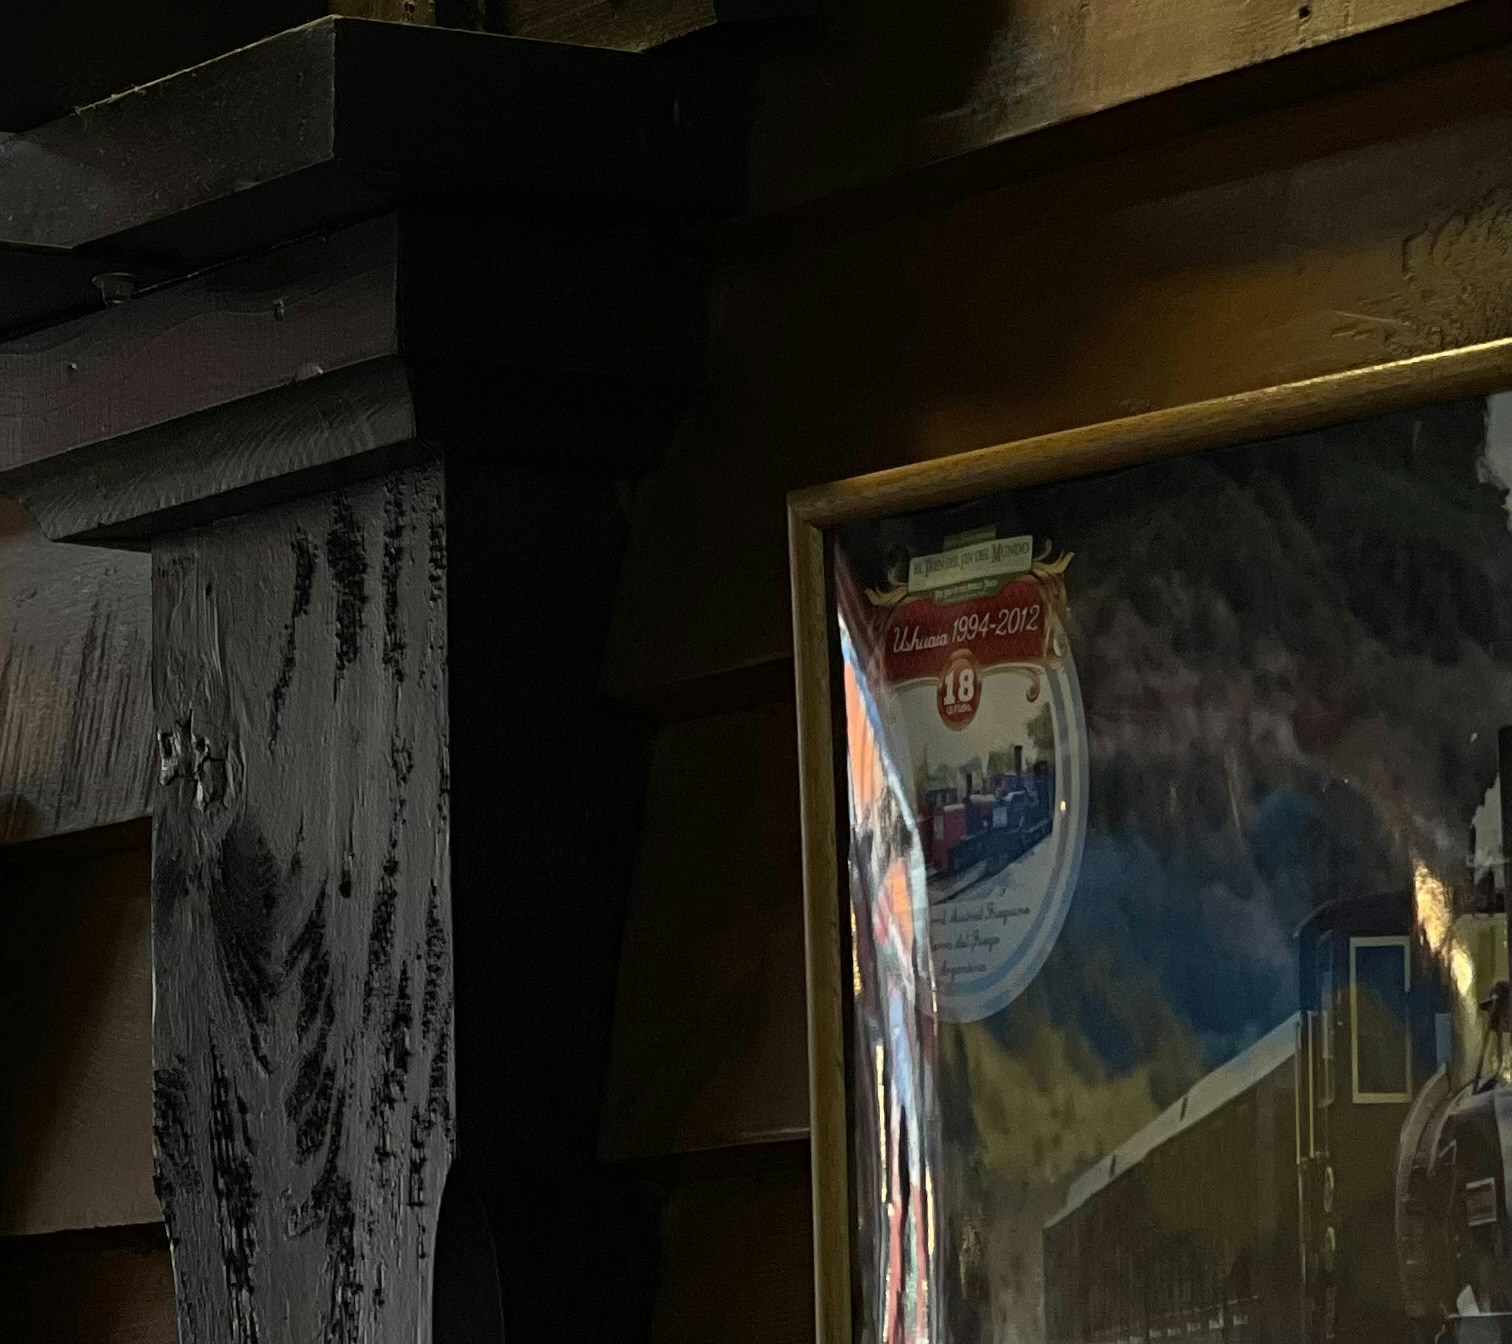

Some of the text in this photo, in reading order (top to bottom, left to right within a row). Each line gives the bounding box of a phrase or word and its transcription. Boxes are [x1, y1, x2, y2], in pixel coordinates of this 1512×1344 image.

[893, 604, 1040, 654] Ushuaia 1994-2012
[943, 668, 975, 706] 18
